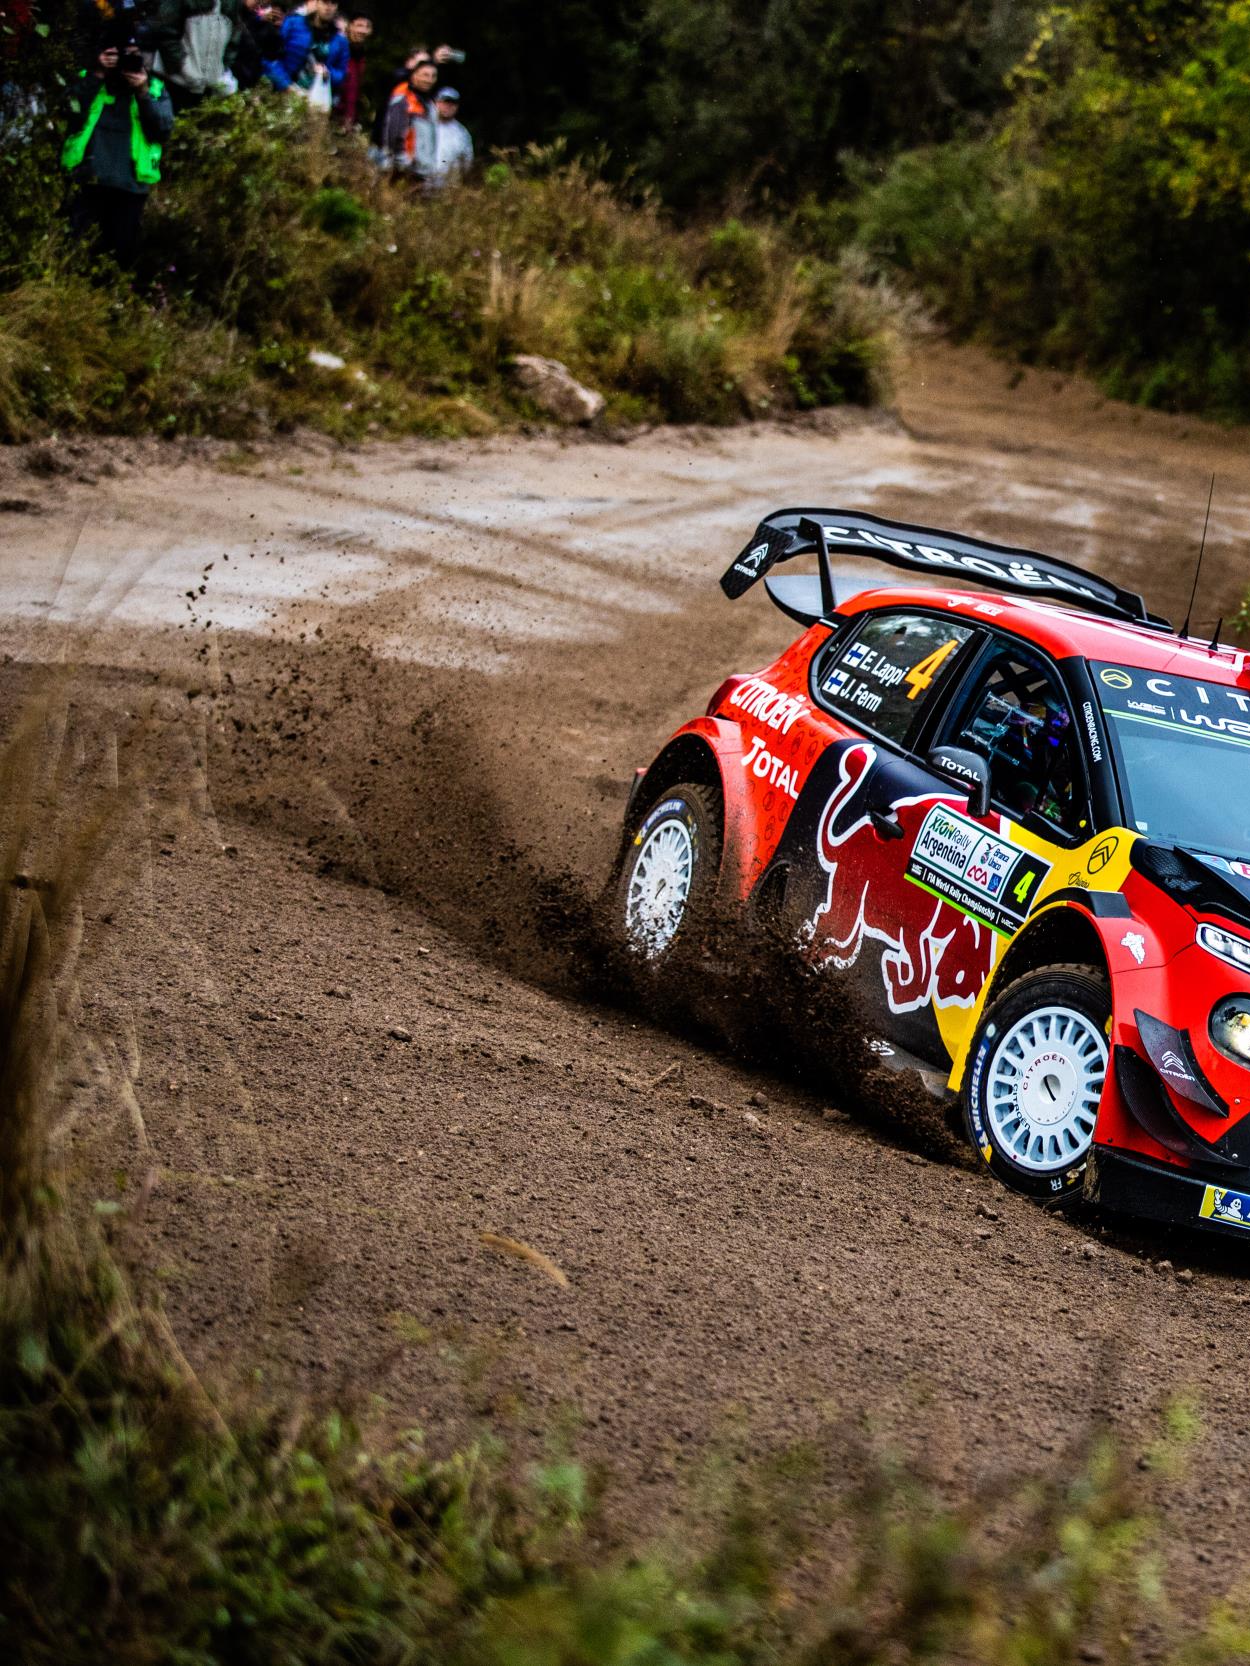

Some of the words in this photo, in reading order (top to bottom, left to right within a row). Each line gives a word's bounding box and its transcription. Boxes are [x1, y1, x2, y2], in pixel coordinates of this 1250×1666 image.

[860, 650, 878, 672] E.
[871, 656, 910, 687] Lappi
[904, 639, 959, 700] 4
[730, 678, 811, 735] CITROËN
[840, 679, 856, 698] J.
[850, 682, 883, 713] Ferm
[741, 735, 799, 800] TOTAL
[940, 756, 981, 782] TOTAL
[921, 830, 967, 869] Argentina
[929, 816, 957, 840] XION
[951, 829, 972, 851] Rally
[927, 872, 937, 885] FIA
[936, 877, 950, 893] World
[949, 884, 962, 902] Rally
[961, 893, 996, 921] Championship
[1013, 870, 1036, 904] 4
[970, 1044, 987, 1131] MICHELIN
[1160, 1068, 1195, 1082] CITROËN
